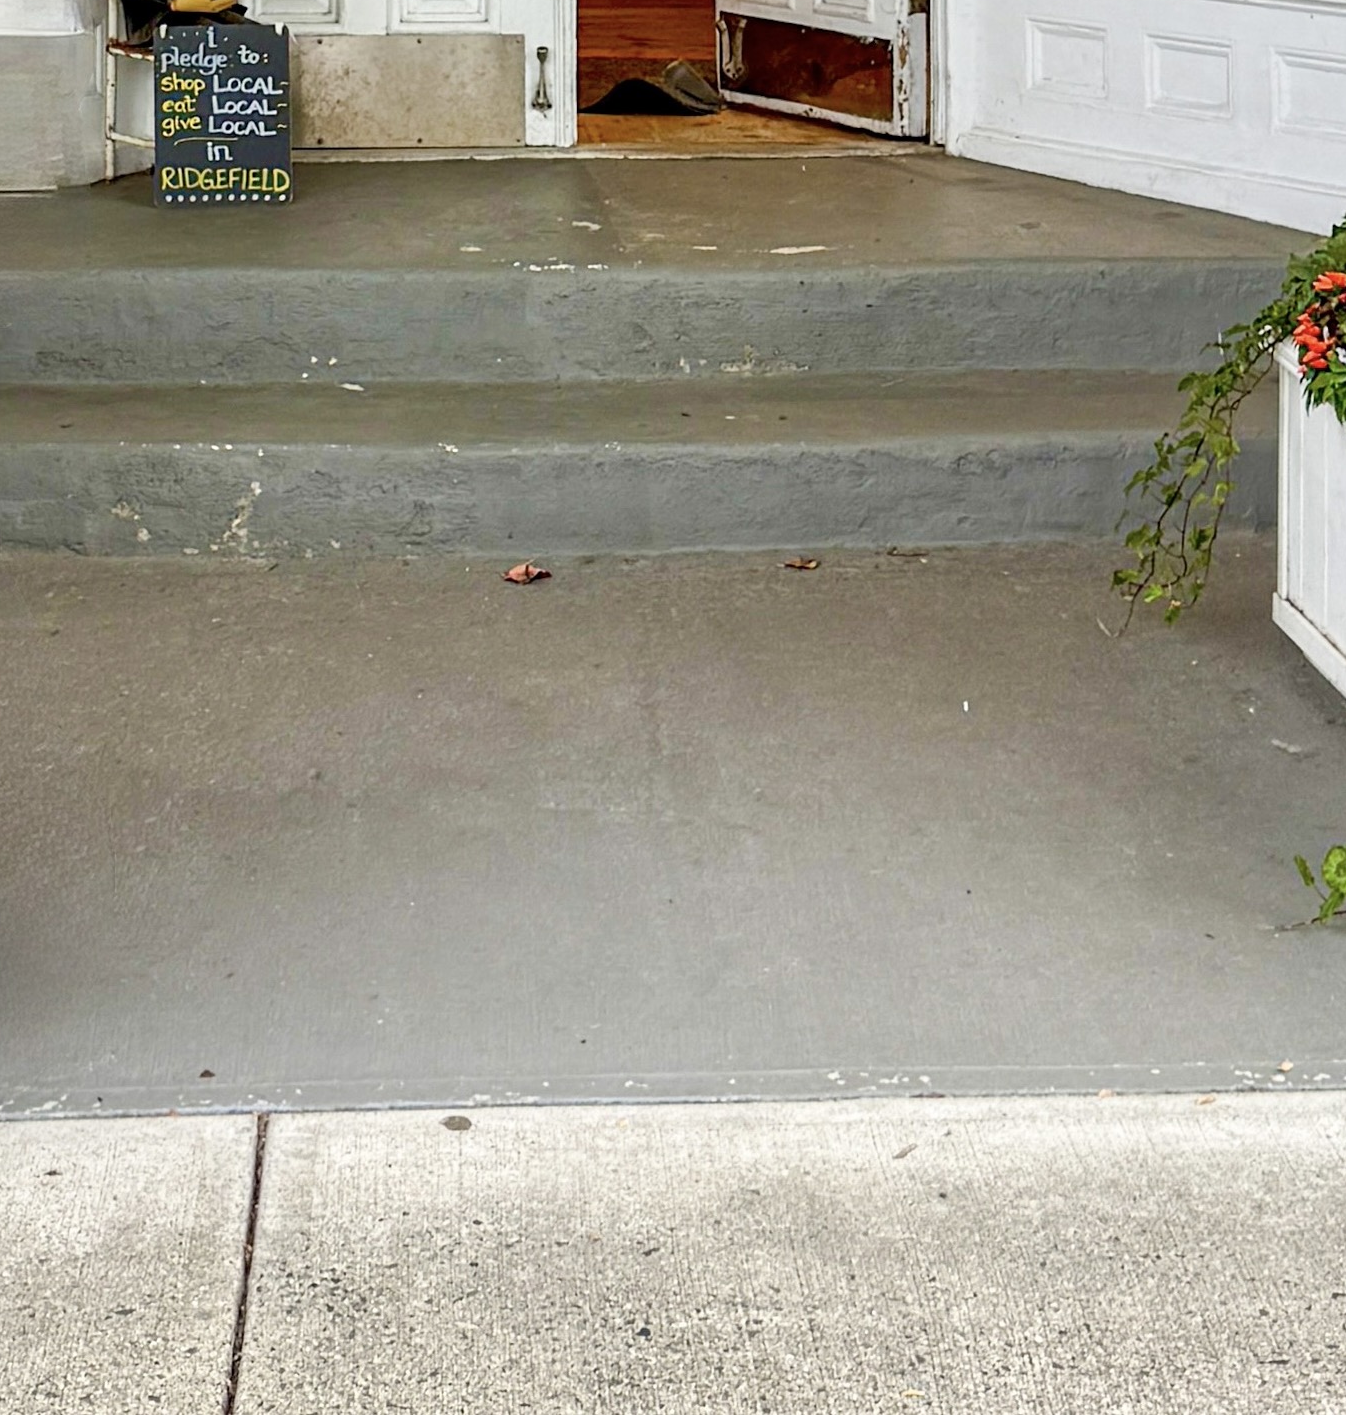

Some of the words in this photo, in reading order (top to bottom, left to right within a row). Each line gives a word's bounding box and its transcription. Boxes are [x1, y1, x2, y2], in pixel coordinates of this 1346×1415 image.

[159, 49, 229, 77] pledge
[160, 72, 206, 97] shop
[161, 95, 197, 114] eat
[160, 111, 203, 137] give
[205, 140, 234, 163] in
[160, 166, 291, 194] RIDGEFIELD
